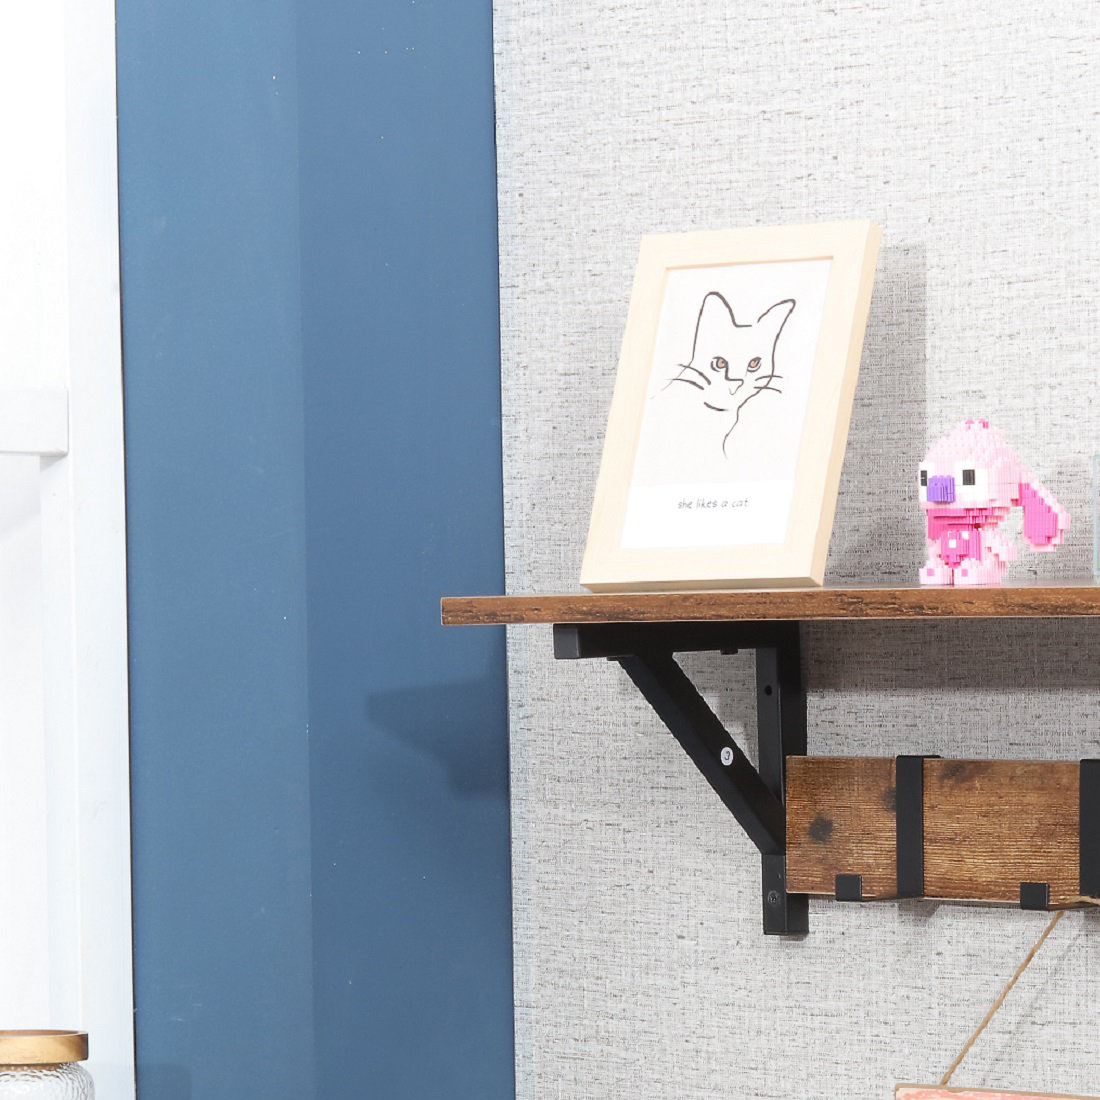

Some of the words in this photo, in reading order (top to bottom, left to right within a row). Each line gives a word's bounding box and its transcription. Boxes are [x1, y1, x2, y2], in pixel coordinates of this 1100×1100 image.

[678, 498, 693, 509] she
[696, 497, 719, 509] likes
[731, 498, 748, 508] cat
